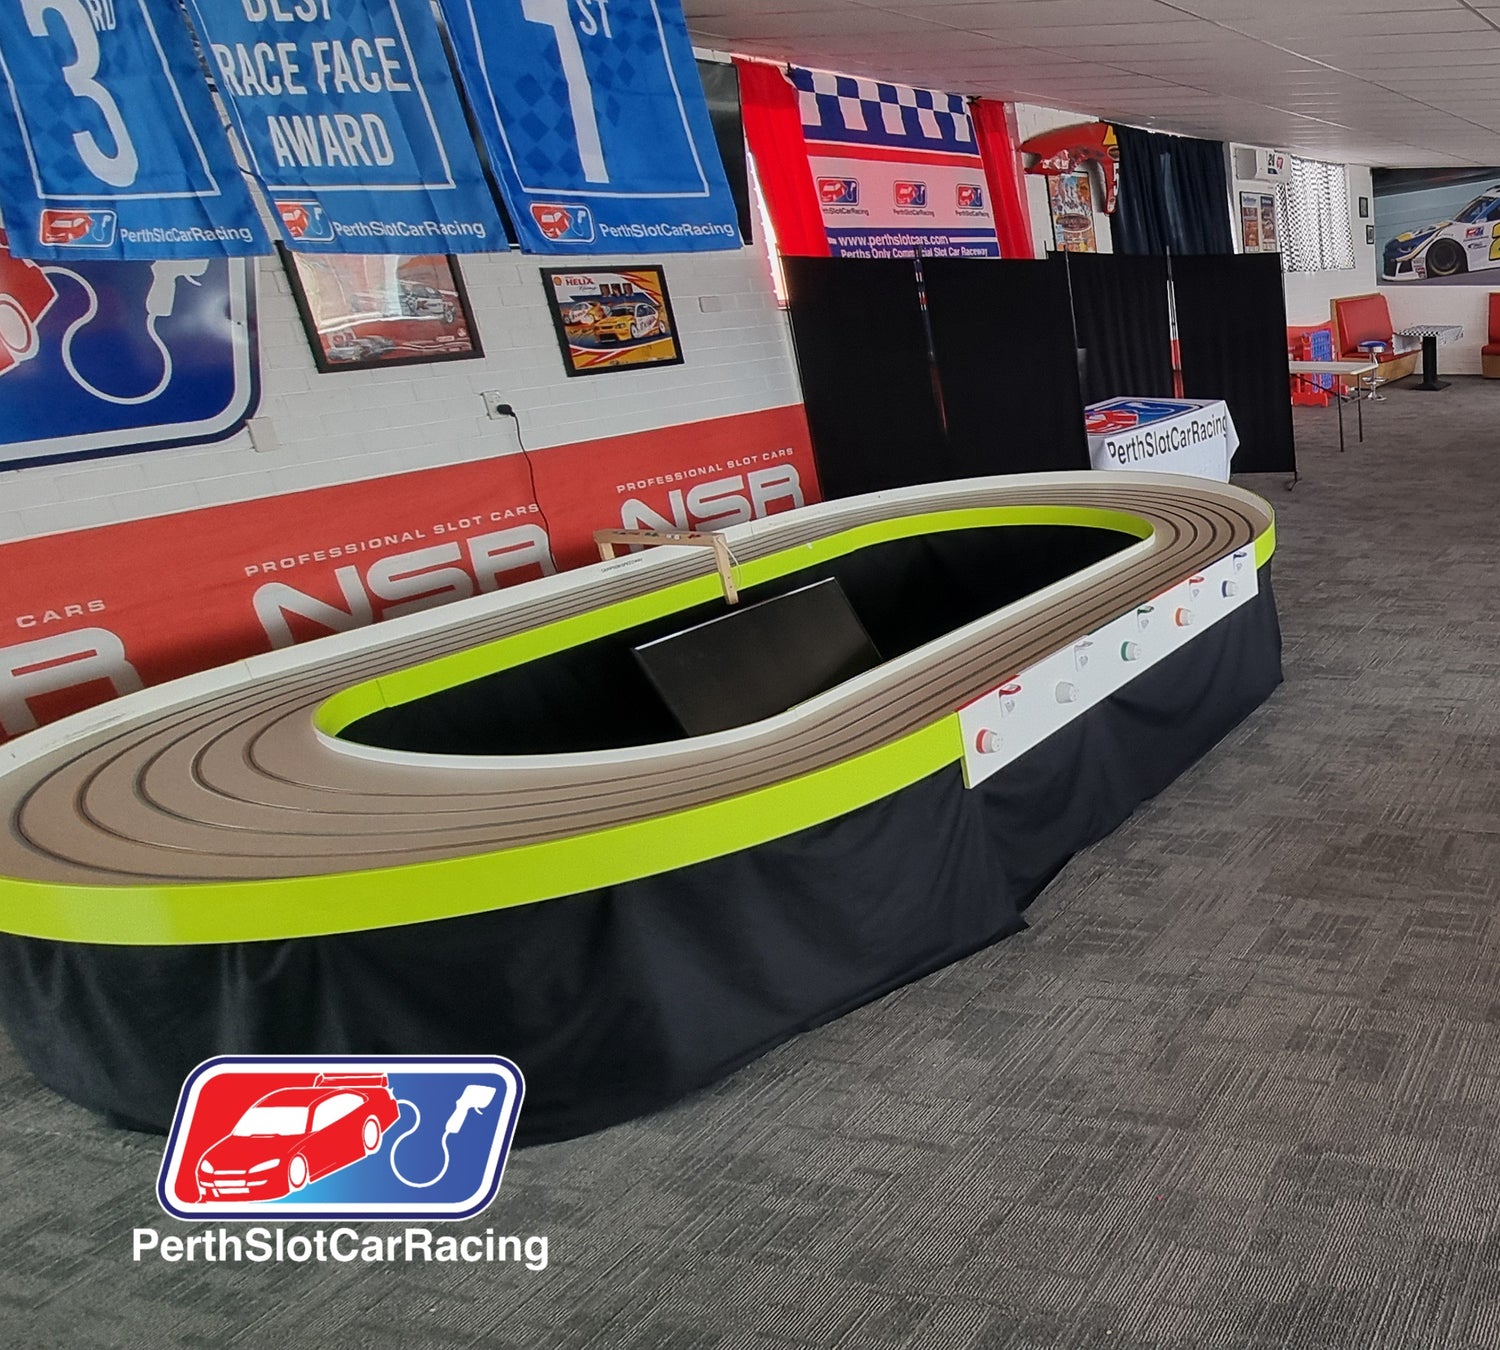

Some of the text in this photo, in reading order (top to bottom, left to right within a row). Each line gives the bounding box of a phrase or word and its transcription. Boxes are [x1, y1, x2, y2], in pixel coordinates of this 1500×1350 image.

[211, 37, 411, 97] RACE FACE
[22, 0, 139, 187] 3
[267, 113, 394, 167] AWARD
[332, 220, 486, 239] PerthSlotCarRacing
[599, 222, 735, 238] PerthSlotCarRacing
[838, 232, 949, 248] www.perthslotcars.com
[565, 276, 594, 286] HELIX
[1106, 413, 1229, 465] PerthSlotCarRacing
[616, 447, 794, 494] PROFESSIONAL SLOT CARS
[620, 463, 805, 552] NSR
[244, 503, 541, 578] PROFESSIONAL SLOT CARS
[253, 523, 558, 650] NSR
[16, 599, 106, 628] CARS
